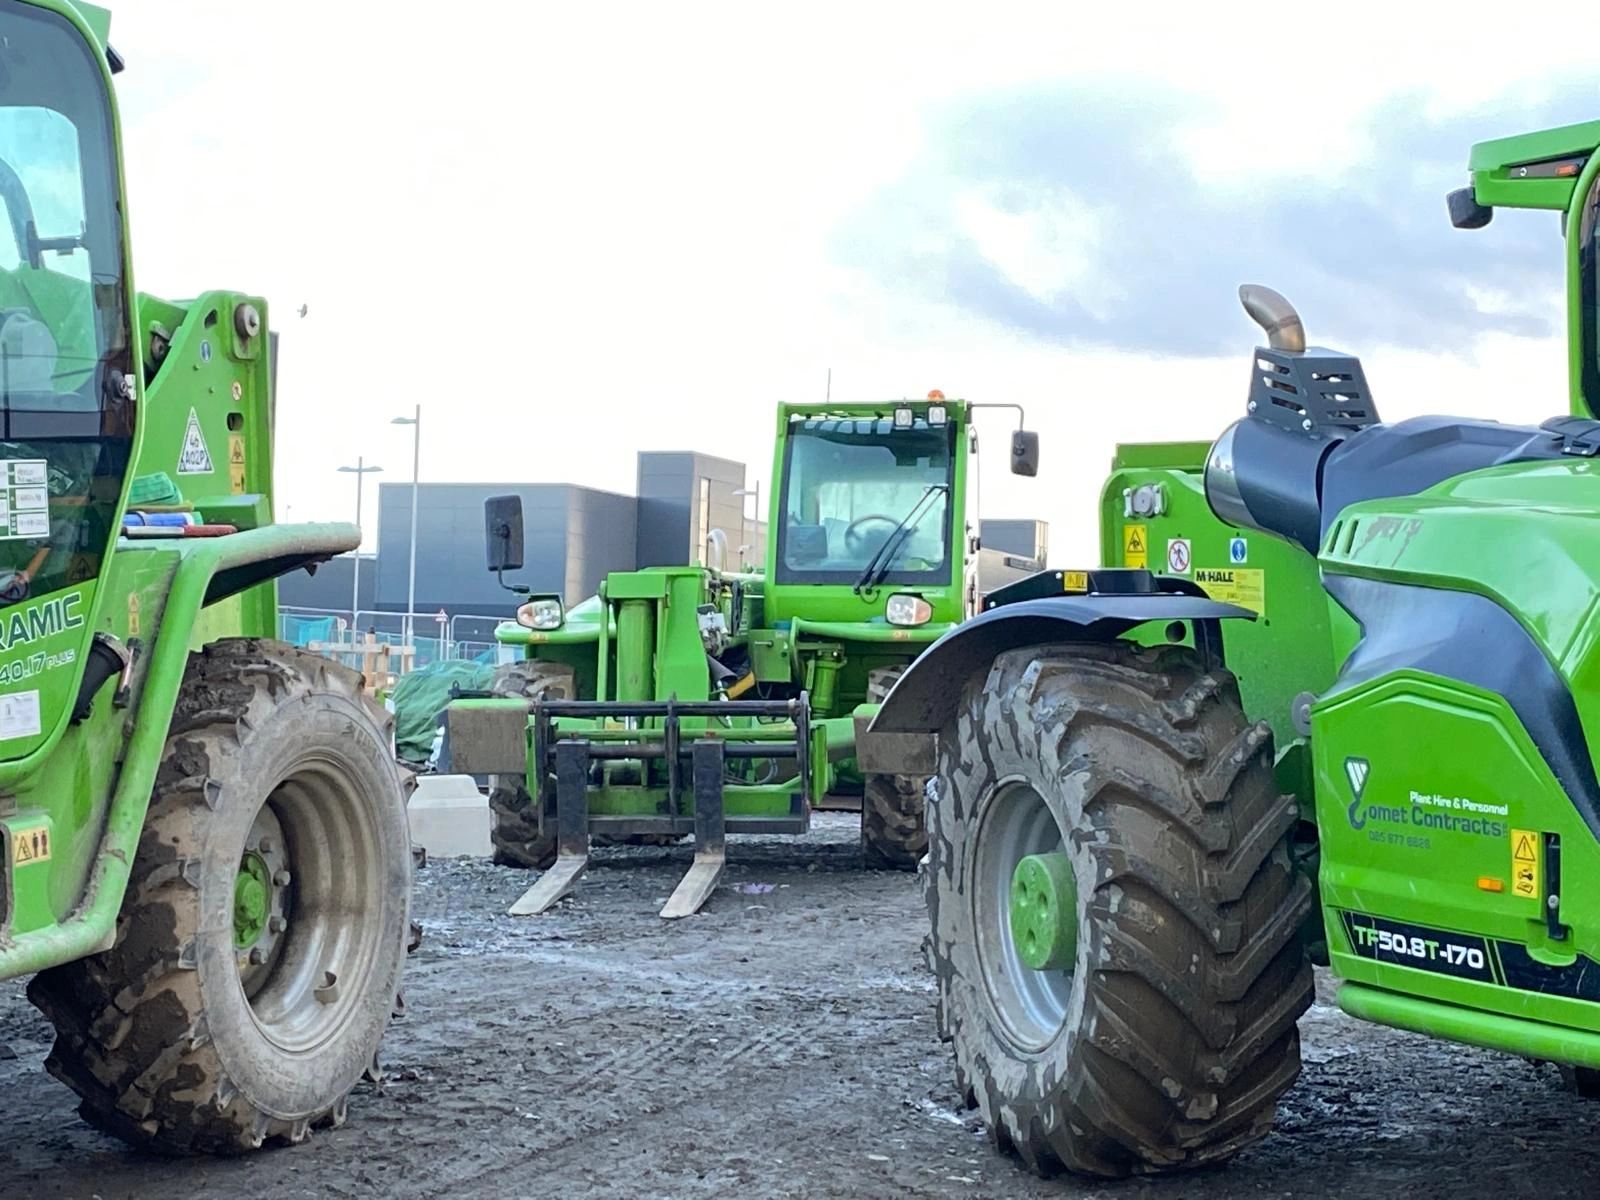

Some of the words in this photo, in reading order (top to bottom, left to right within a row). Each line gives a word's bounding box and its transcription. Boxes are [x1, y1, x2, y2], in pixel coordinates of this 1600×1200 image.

[46, 649, 75, 670] PLUS
[1409, 790, 1432, 805] Plant
[1433, 794, 1451, 807] Hire
[1453, 797, 1461, 809] &
[1462, 798, 1508, 816] Personnel
[1411, 806, 1502, 837] Contracts
[1353, 924, 1484, 969] TF50.8T-170
